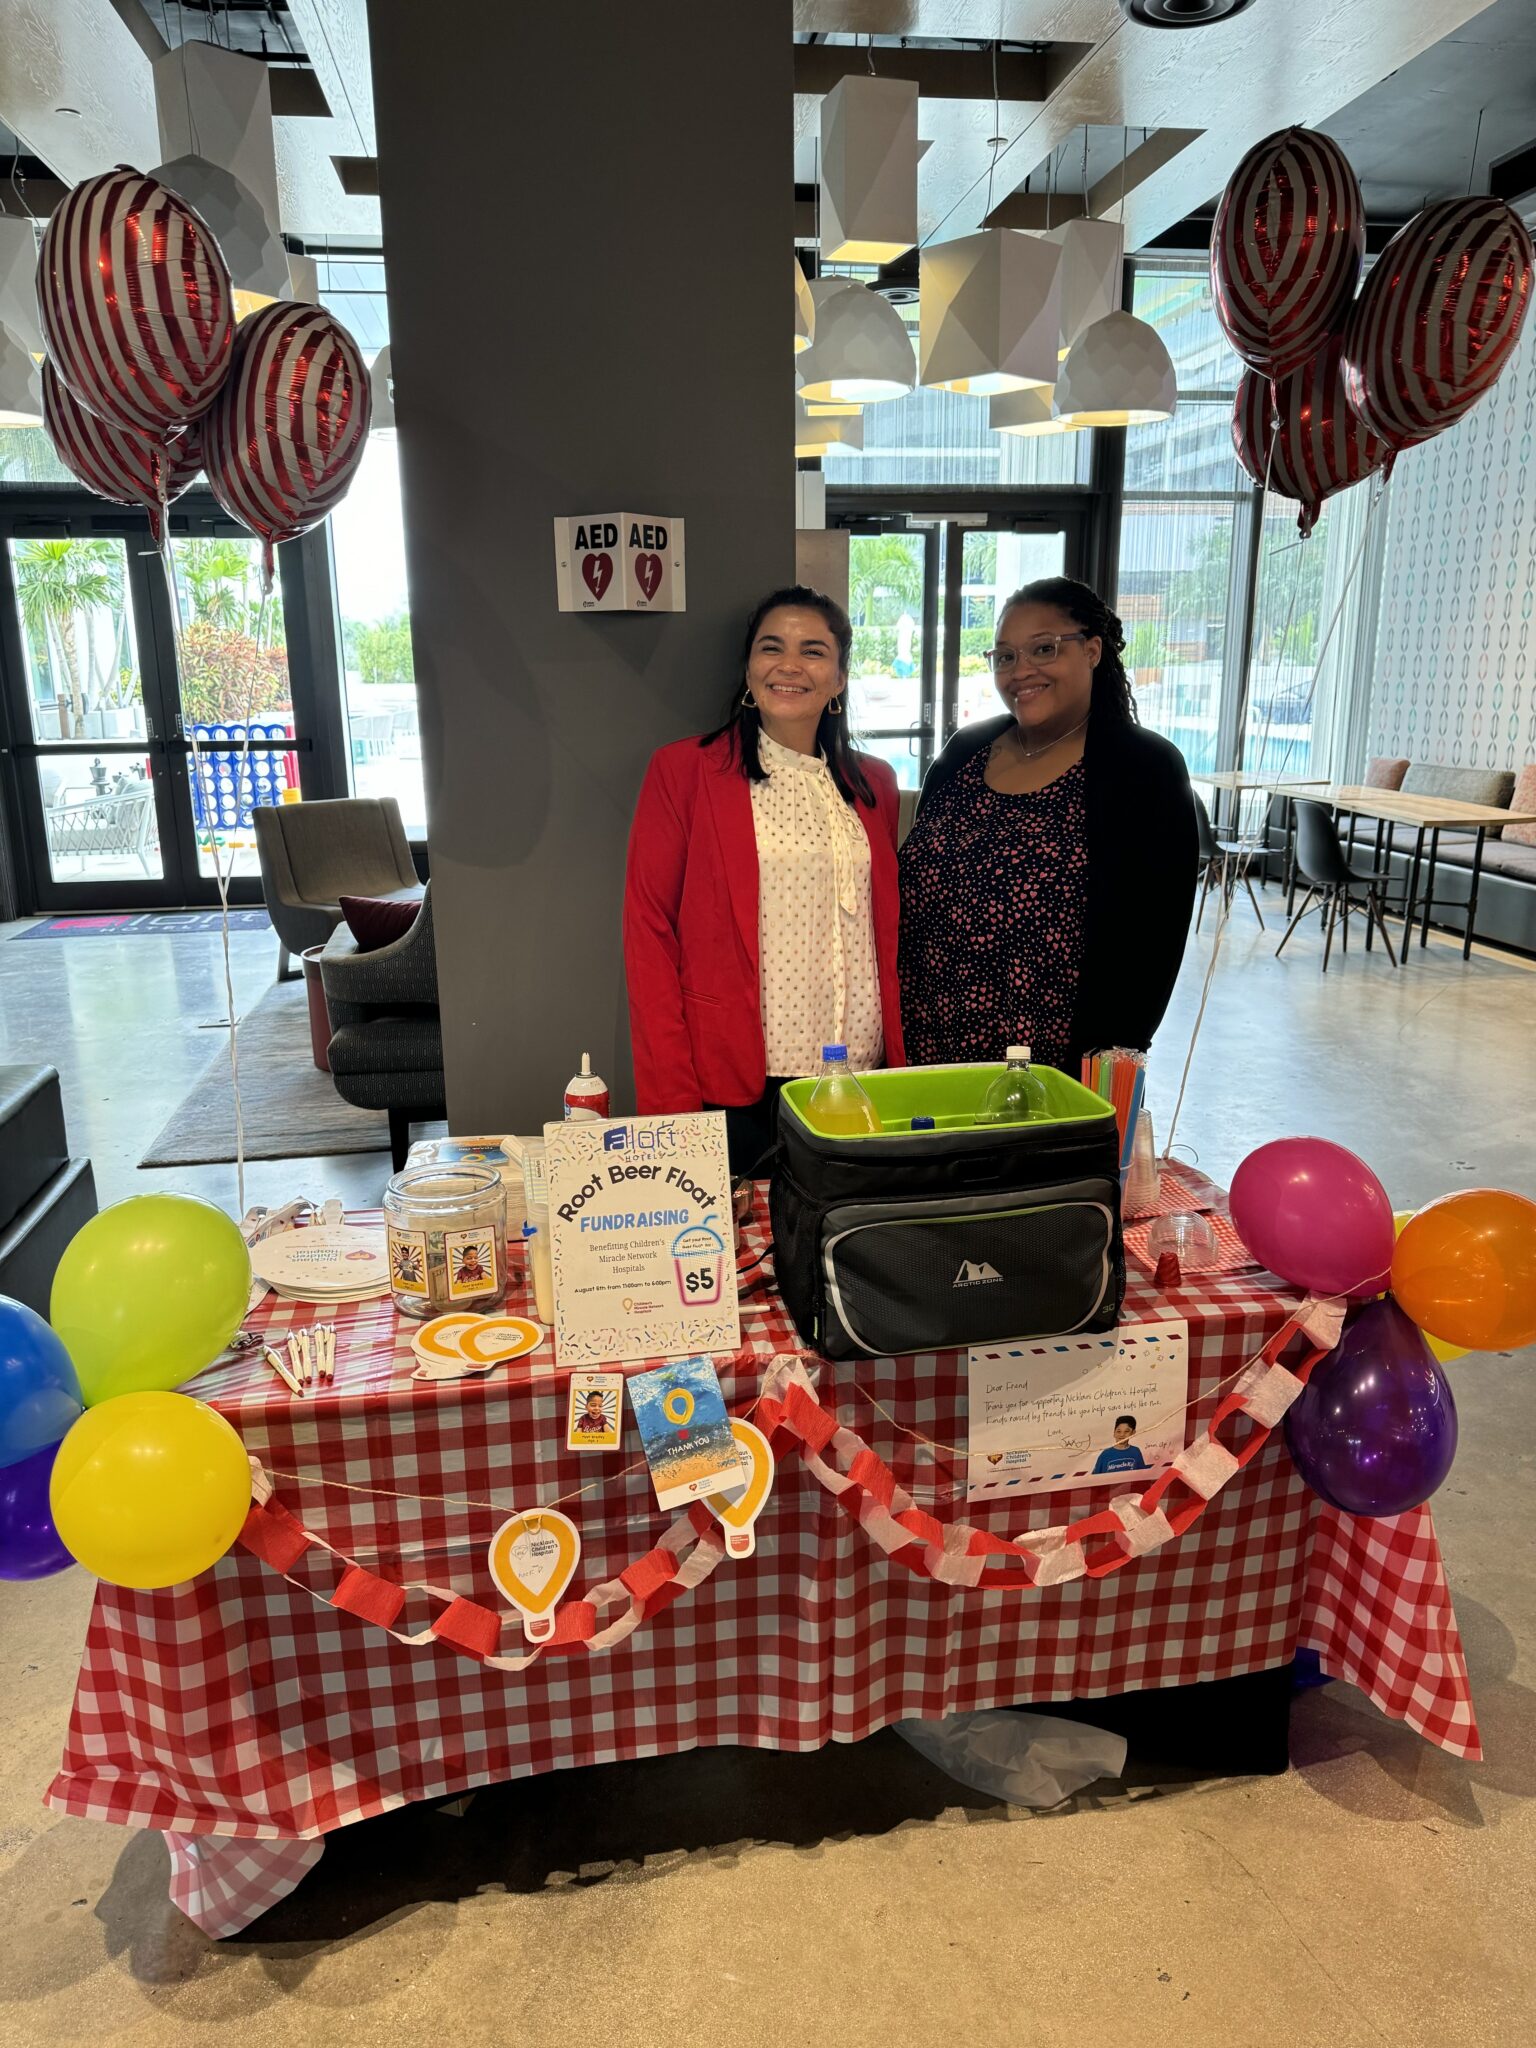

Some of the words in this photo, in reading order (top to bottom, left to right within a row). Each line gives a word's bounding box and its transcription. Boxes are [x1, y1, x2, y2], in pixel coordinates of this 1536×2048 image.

[575, 523, 618, 550] AED
[629, 523, 667, 550] AED
[101, 925, 212, 933] HOTELS
[625, 1152, 666, 1163] HOTELS
[557, 1173, 603, 1222] Root
[608, 1164, 661, 1185] Beer
[665, 1166, 717, 1210] Float
[580, 1209, 689, 1233] FUNDRAISING
[589, 1241, 629, 1252] Benefitting
[630, 1238, 665, 1249] Children's
[599, 1253, 626, 1263] Miracle
[627, 1251, 657, 1261] Network
[612, 1264, 646, 1275] Hospitals
[686, 1267, 714, 1293] $5
[953, 1280, 981, 1288] ARCTIC
[982, 1277, 1004, 1285] ZONE
[574, 1286, 595, 1294] August
[986, 1384, 1003, 1394] Dear
[1006, 1380, 1028, 1391] Friend
[984, 1401, 1003, 1412] Thank
[1006, 1403, 1017, 1412] you
[1018, 1399, 1028, 1411] for
[1031, 1394, 1065, 1410] supporting
[1094, 1388, 1127, 1400] Children's
[1130, 1383, 1158, 1398] Hospital
[986, 1415, 1008, 1425] Funds
[1009, 1412, 1030, 1423] raised
[1031, 1411, 1041, 1423] by
[1042, 1409, 1066, 1422] friends
[1079, 1409, 1090, 1418] you
[1092, 1403, 1106, 1417] help
[667, 1442, 694, 1456] THANK
[693, 1435, 710, 1448] YOU
[531, 1543, 558, 1553] Children's
